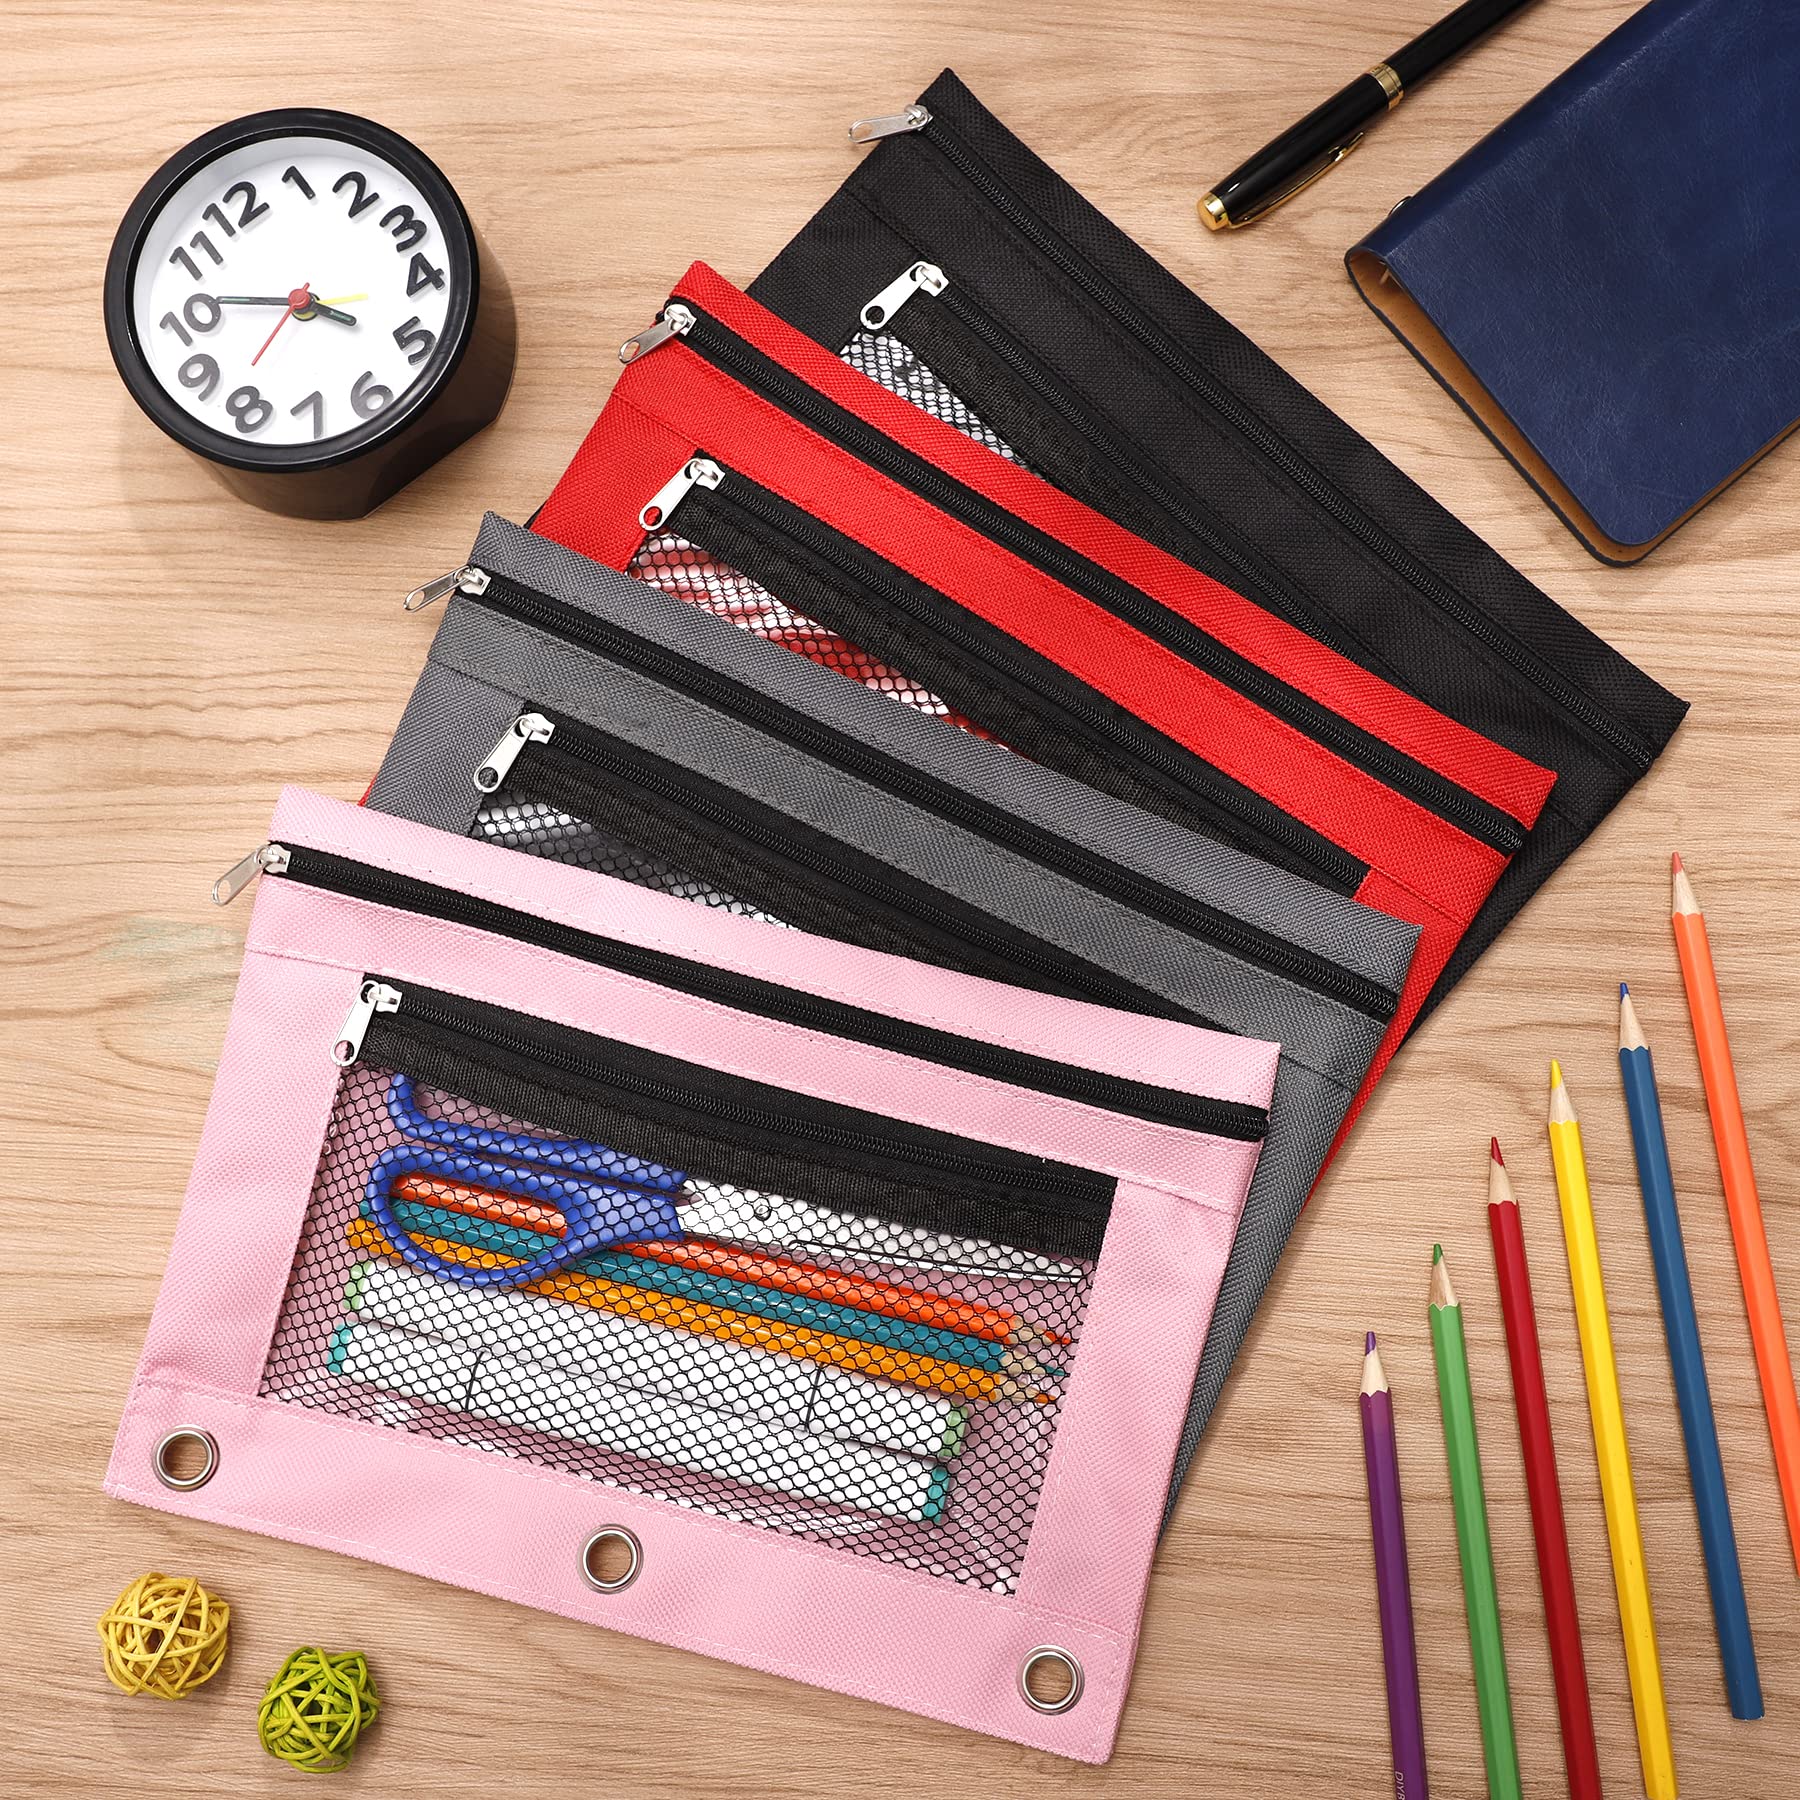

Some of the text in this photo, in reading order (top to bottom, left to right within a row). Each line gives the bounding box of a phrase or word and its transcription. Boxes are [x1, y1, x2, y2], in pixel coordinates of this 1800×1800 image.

[282, 166, 315, 200] 1
[333, 172, 379, 218] 2
[203, 182, 269, 237] 12
[380, 205, 426, 252] 3
[170, 232, 223, 280] 11
[406, 253, 445, 297] 4
[160, 294, 221, 346] 10
[393, 317, 435, 365] 5
[178, 354, 220, 401] 9
[351, 372, 394, 419] 6
[226, 386, 273, 433] 8
[291, 391, 323, 438] 7
